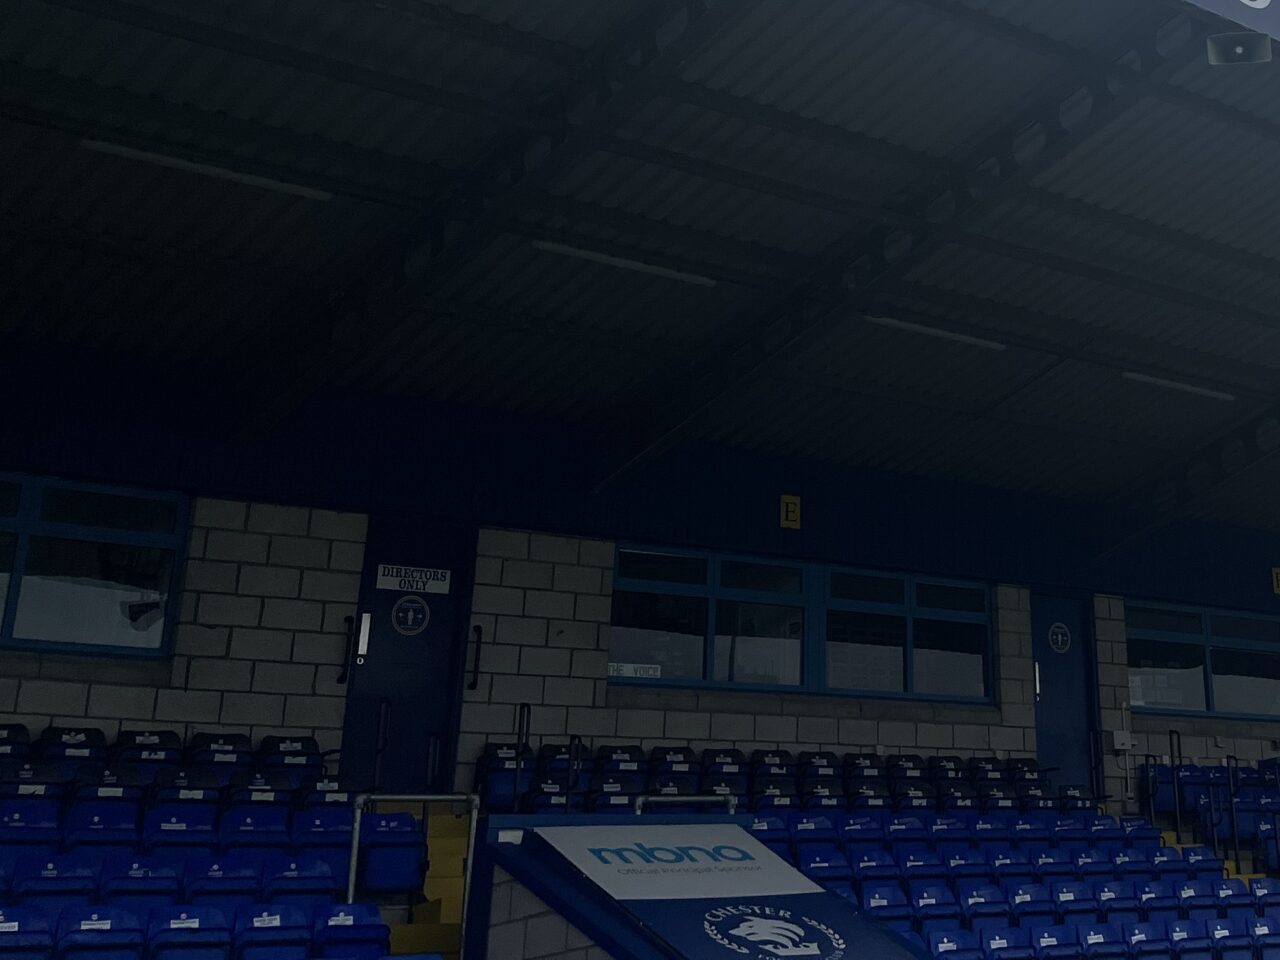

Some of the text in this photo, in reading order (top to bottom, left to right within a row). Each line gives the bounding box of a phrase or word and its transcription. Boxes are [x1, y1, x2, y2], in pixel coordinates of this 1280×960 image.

[783, 501, 797, 522] E
[382, 566, 447, 582] DIRECTORS
[399, 579, 428, 591] ONLY
[587, 842, 756, 865] mbna
[704, 904, 792, 922] CHESTER
